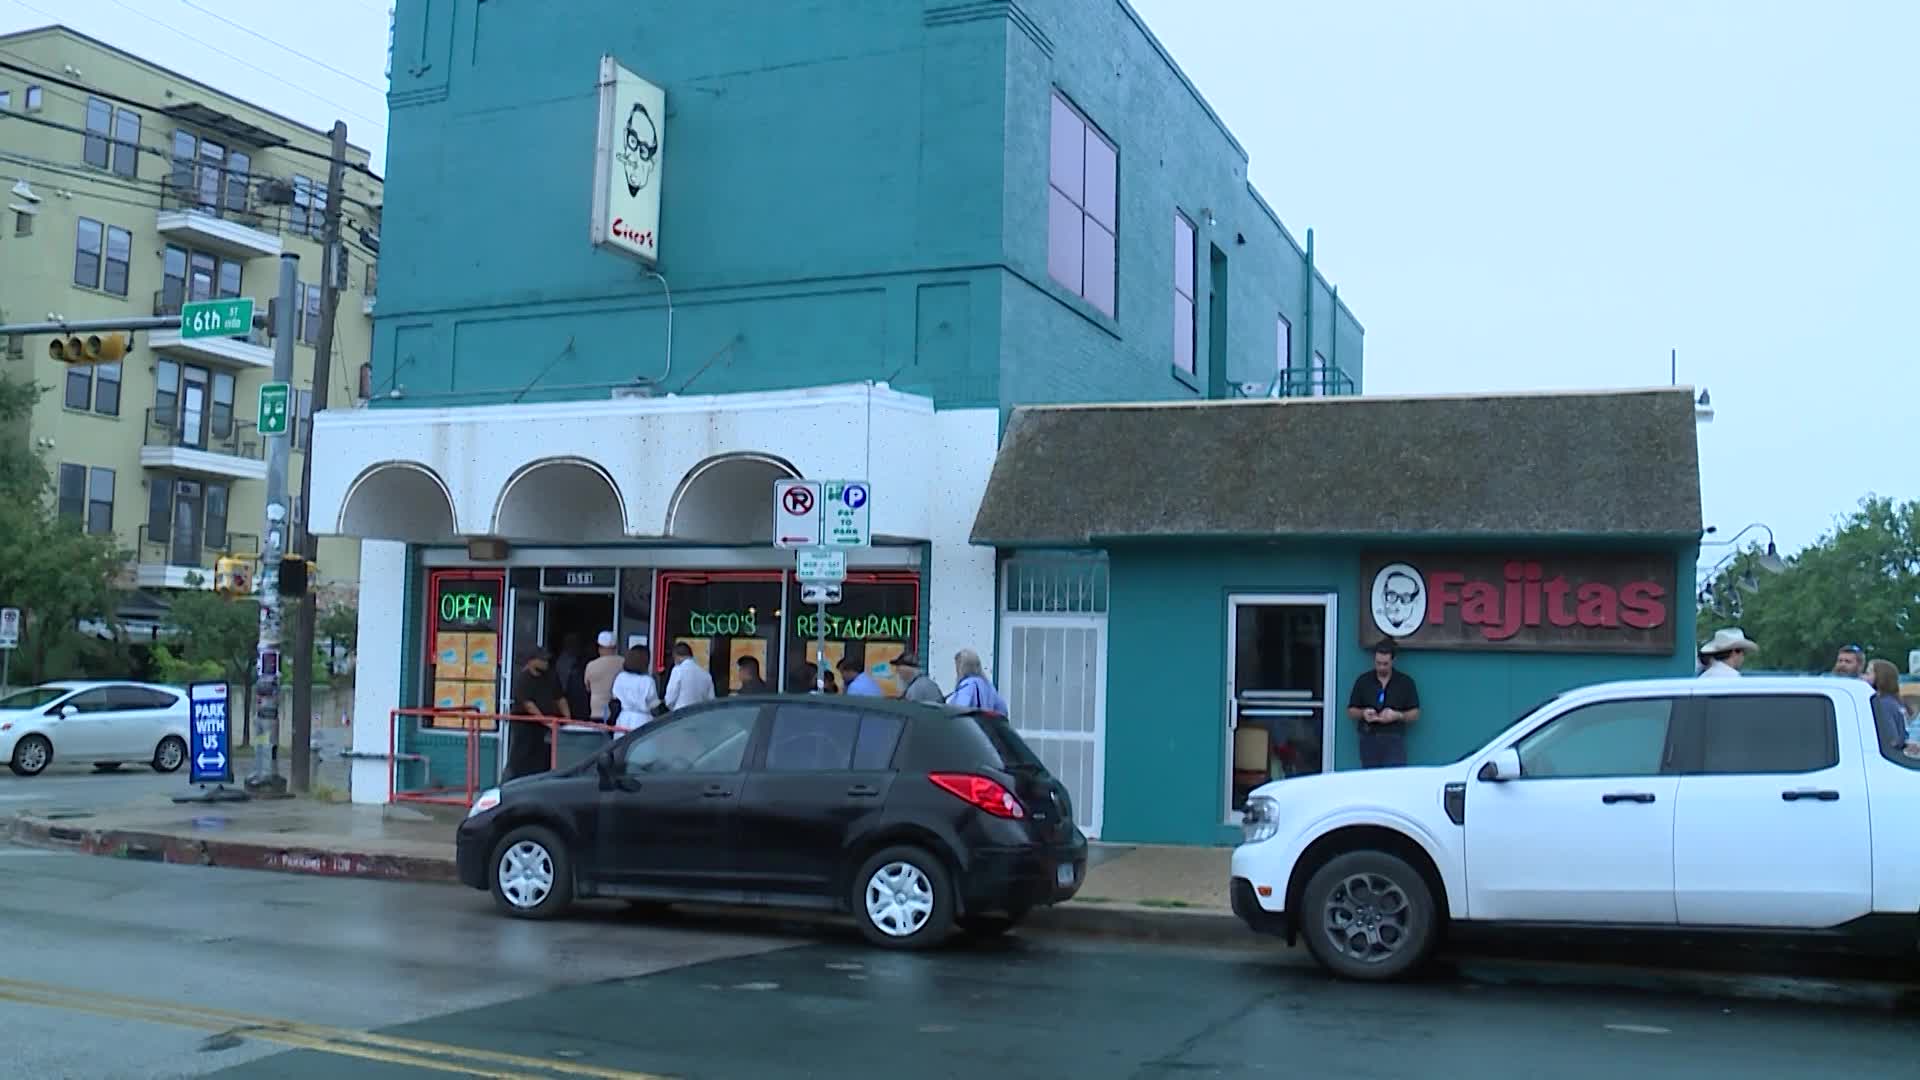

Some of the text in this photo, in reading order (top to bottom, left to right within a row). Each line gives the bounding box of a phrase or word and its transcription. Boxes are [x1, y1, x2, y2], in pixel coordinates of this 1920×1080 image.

[613, 218, 653, 248] Cisco's
[193, 310, 221, 333] 6th
[441, 593, 492, 621] OPEN
[1427, 560, 1667, 641] Fajitas
[690, 611, 757, 636] CISCO'S
[195, 703, 224, 718] PARK
[196, 719, 224, 733] WITH
[203, 734, 218, 749] US
